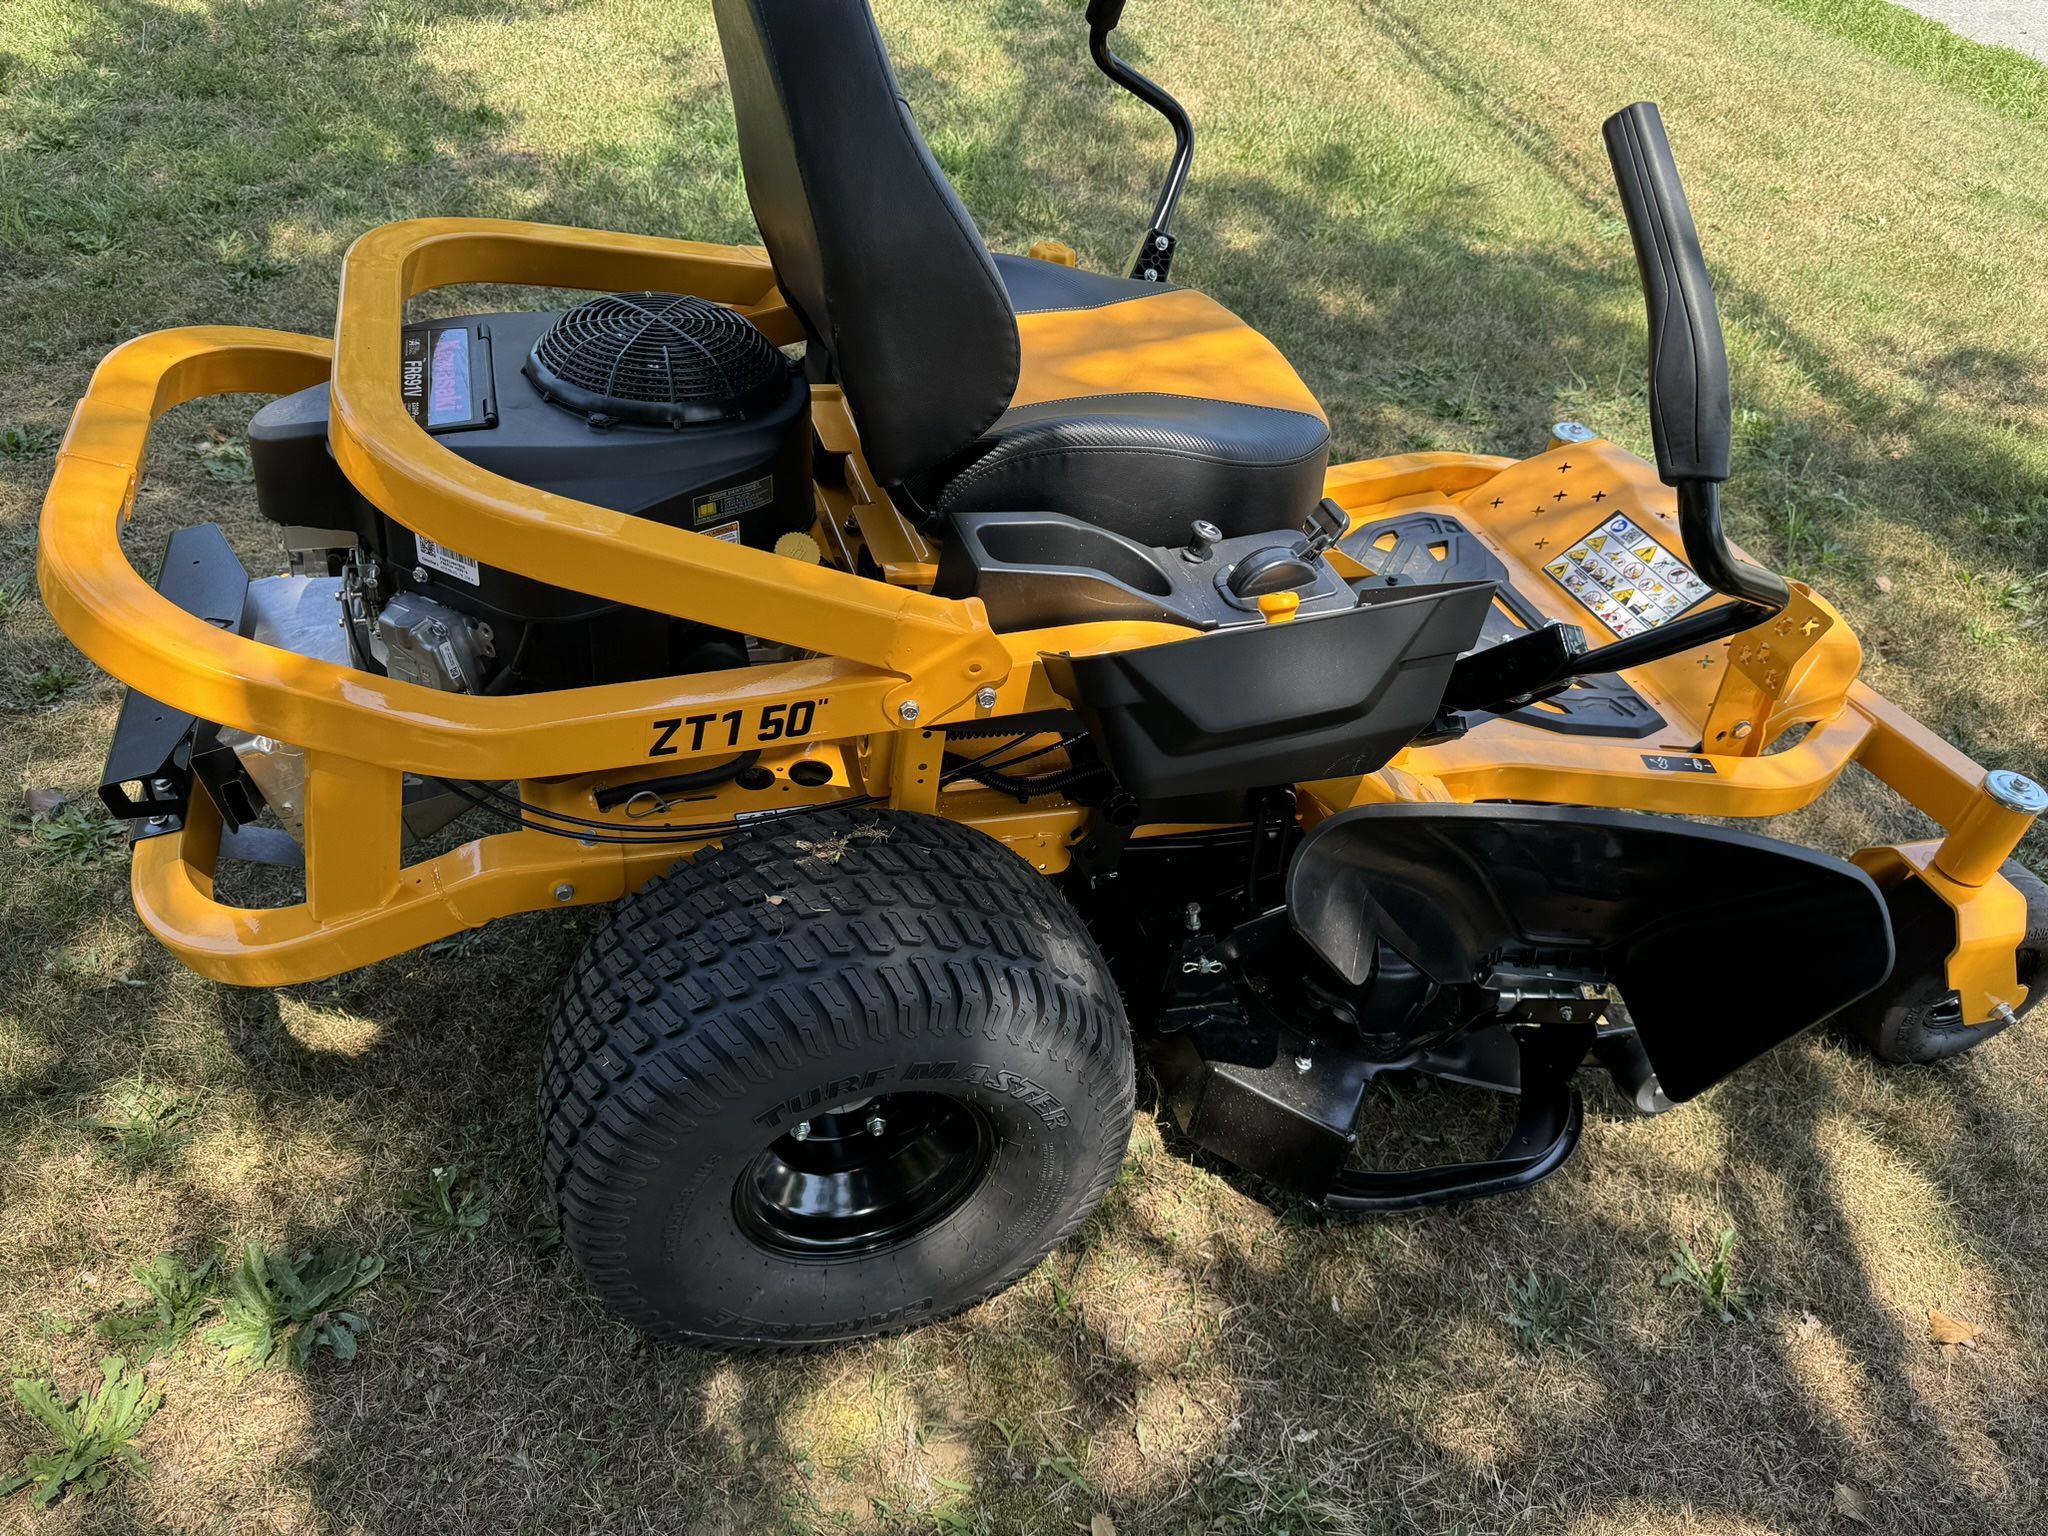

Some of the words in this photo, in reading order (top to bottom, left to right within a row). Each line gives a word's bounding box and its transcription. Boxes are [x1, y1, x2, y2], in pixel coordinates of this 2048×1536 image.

[403, 360, 423, 397] FR691V
[434, 340, 463, 410] Kawasaki
[649, 709, 743, 757] ZT1
[757, 698, 829, 742] 50"
[752, 1064, 897, 1128] TURF
[902, 1060, 1073, 1132] MASTER
[703, 1297, 934, 1336] CARLISLE
